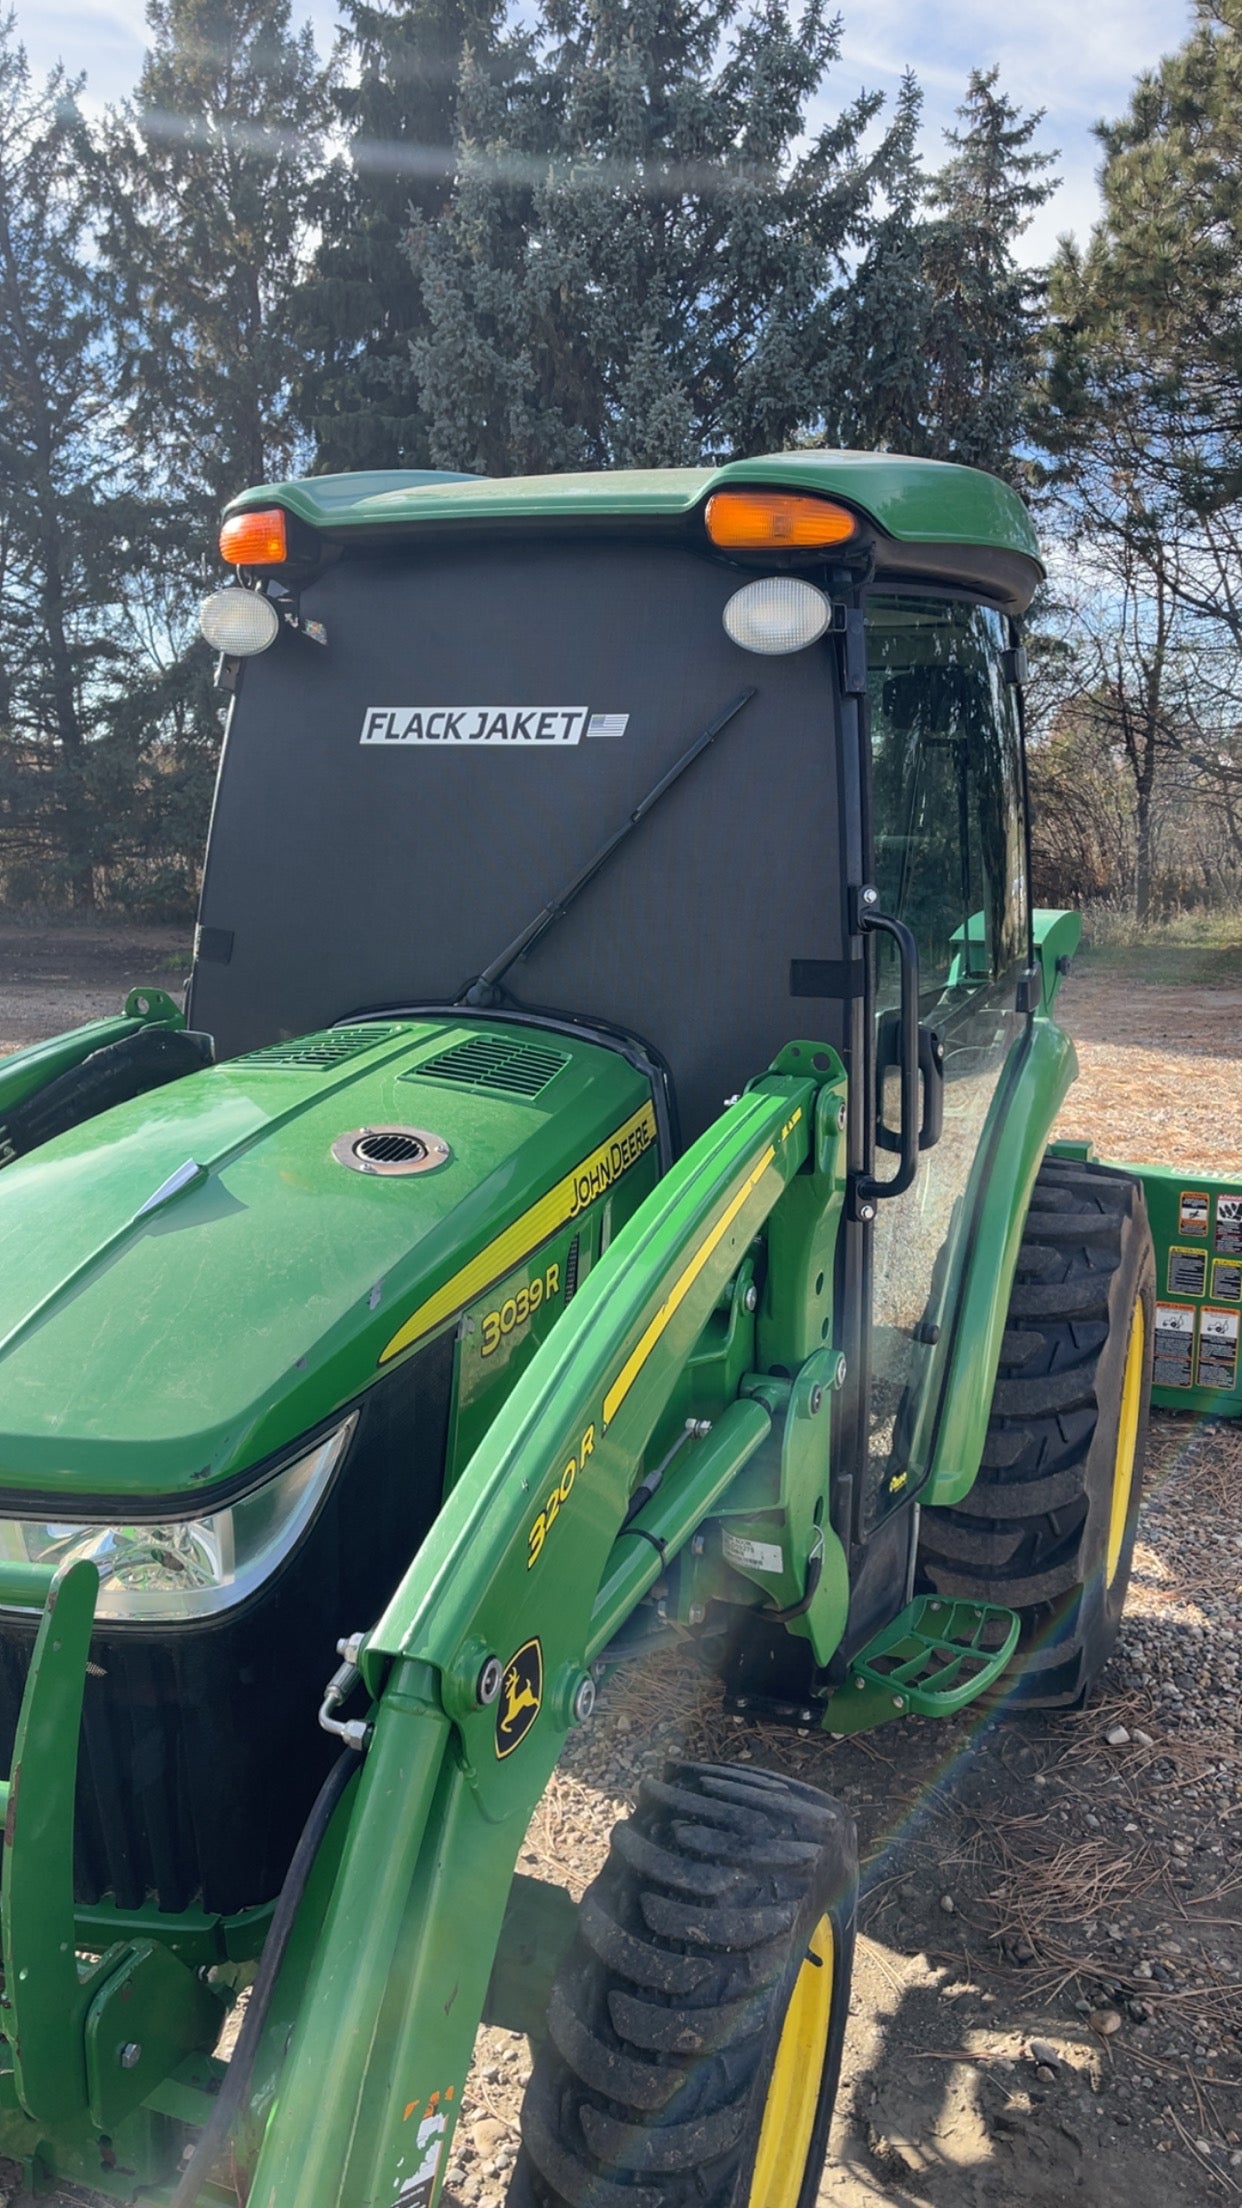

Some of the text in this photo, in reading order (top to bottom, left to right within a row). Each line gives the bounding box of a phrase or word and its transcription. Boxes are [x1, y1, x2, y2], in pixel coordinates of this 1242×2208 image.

[366, 712, 583, 740] FLACK JAKET
[570, 1120, 651, 1214] JOHN DEERE
